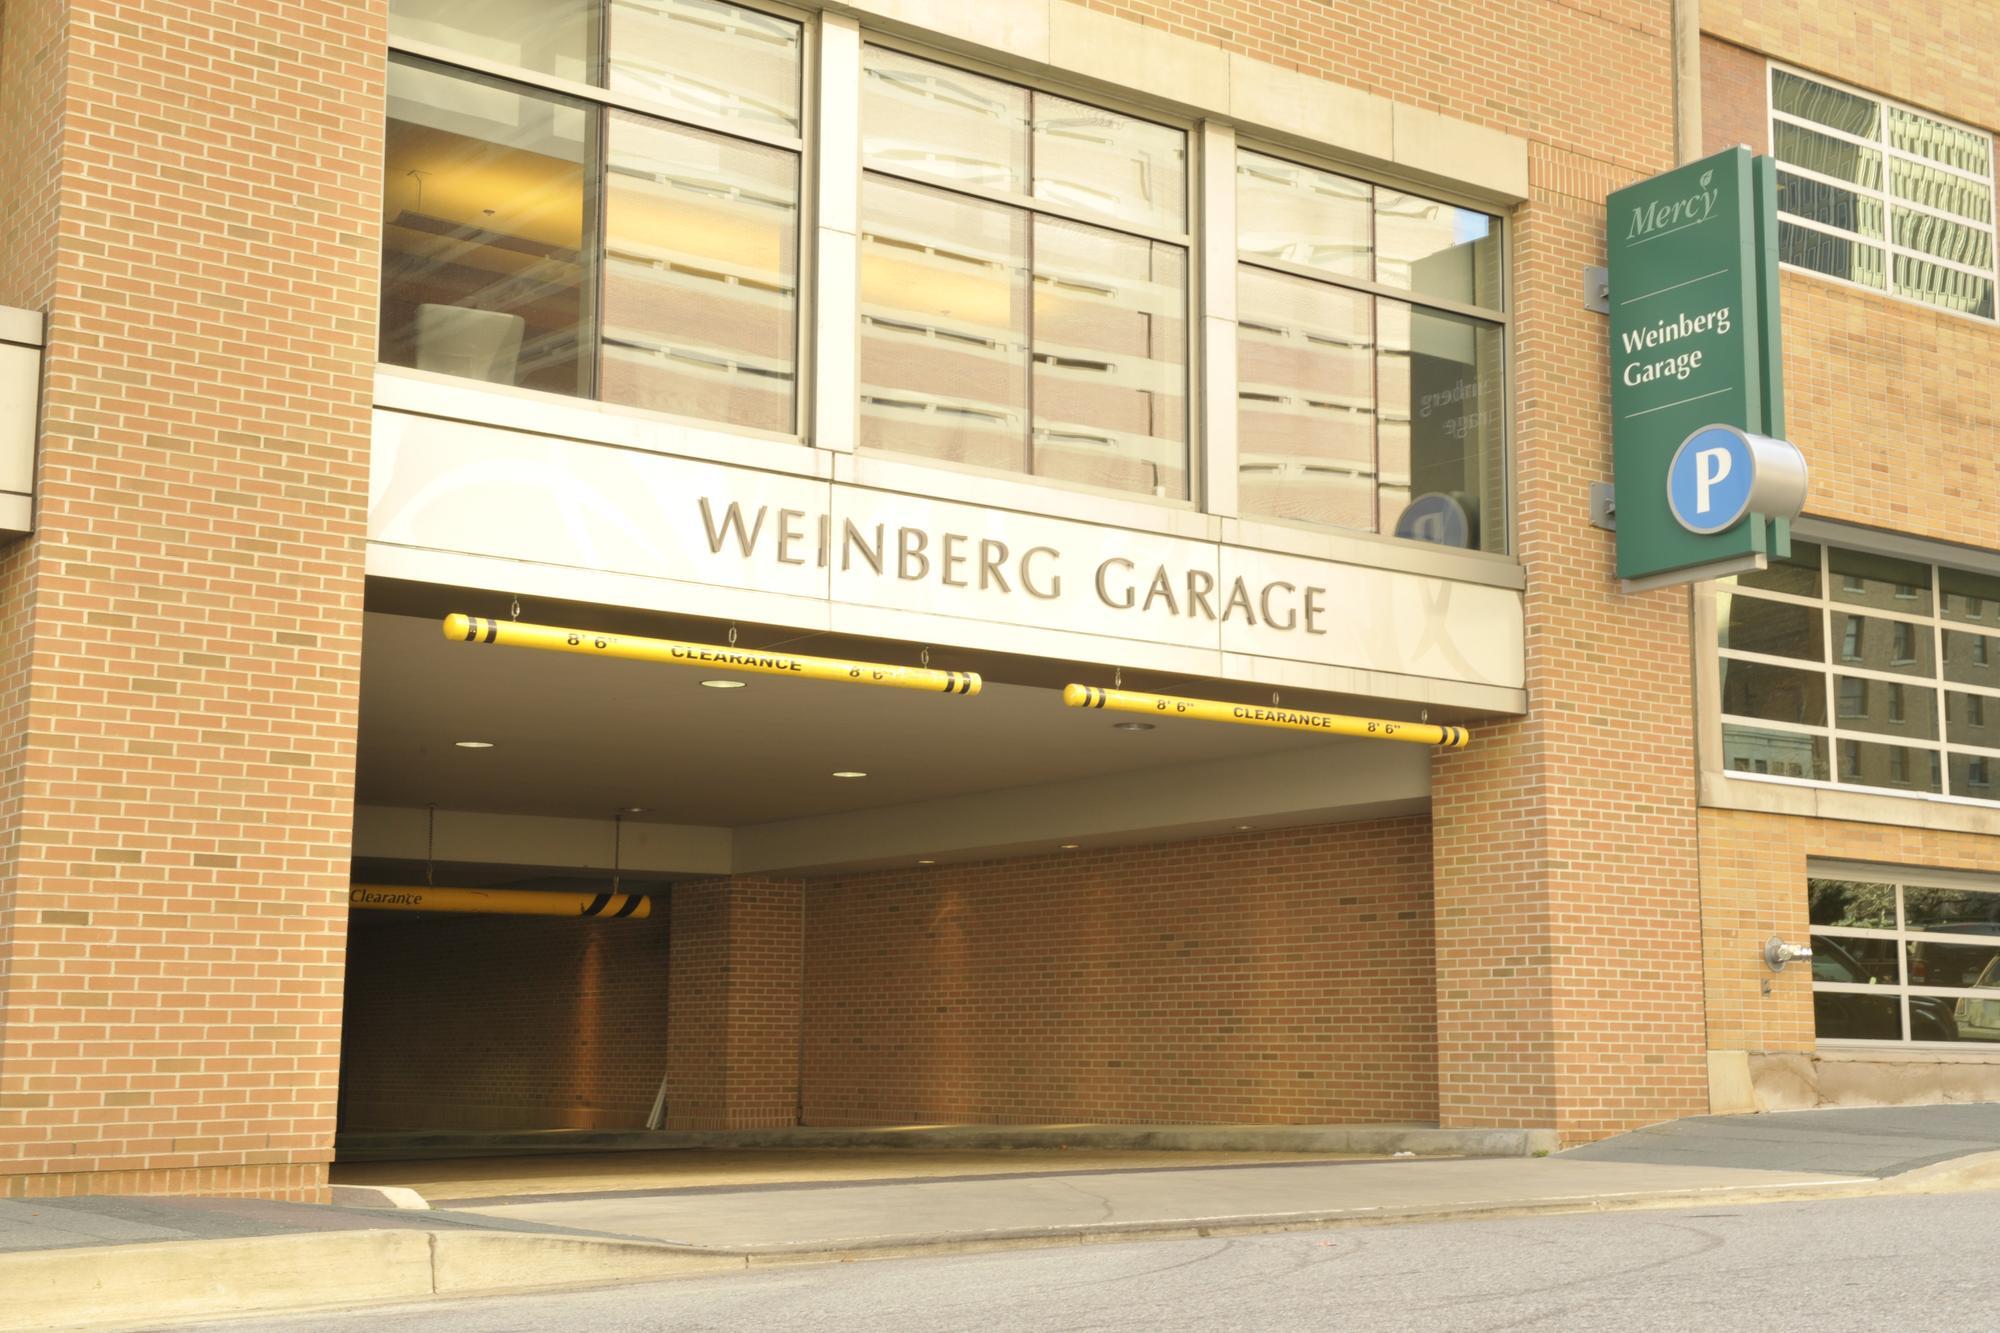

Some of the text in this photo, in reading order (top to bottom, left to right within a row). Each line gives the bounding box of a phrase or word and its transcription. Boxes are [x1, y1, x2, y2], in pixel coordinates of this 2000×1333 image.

[1626, 188, 1718, 240] Mercy
[1622, 307, 1731, 354] Weinberg
[1624, 350, 1703, 387] Garage
[1695, 446, 1732, 514] P
[698, 496, 1328, 635] WEINBERG GARAGE
[671, 645, 802, 672] CLEARANCE
[1233, 707, 1332, 728] CLEARANCE
[1368, 721, 1380, 733] 8'
[350, 888, 423, 906] Clearance
